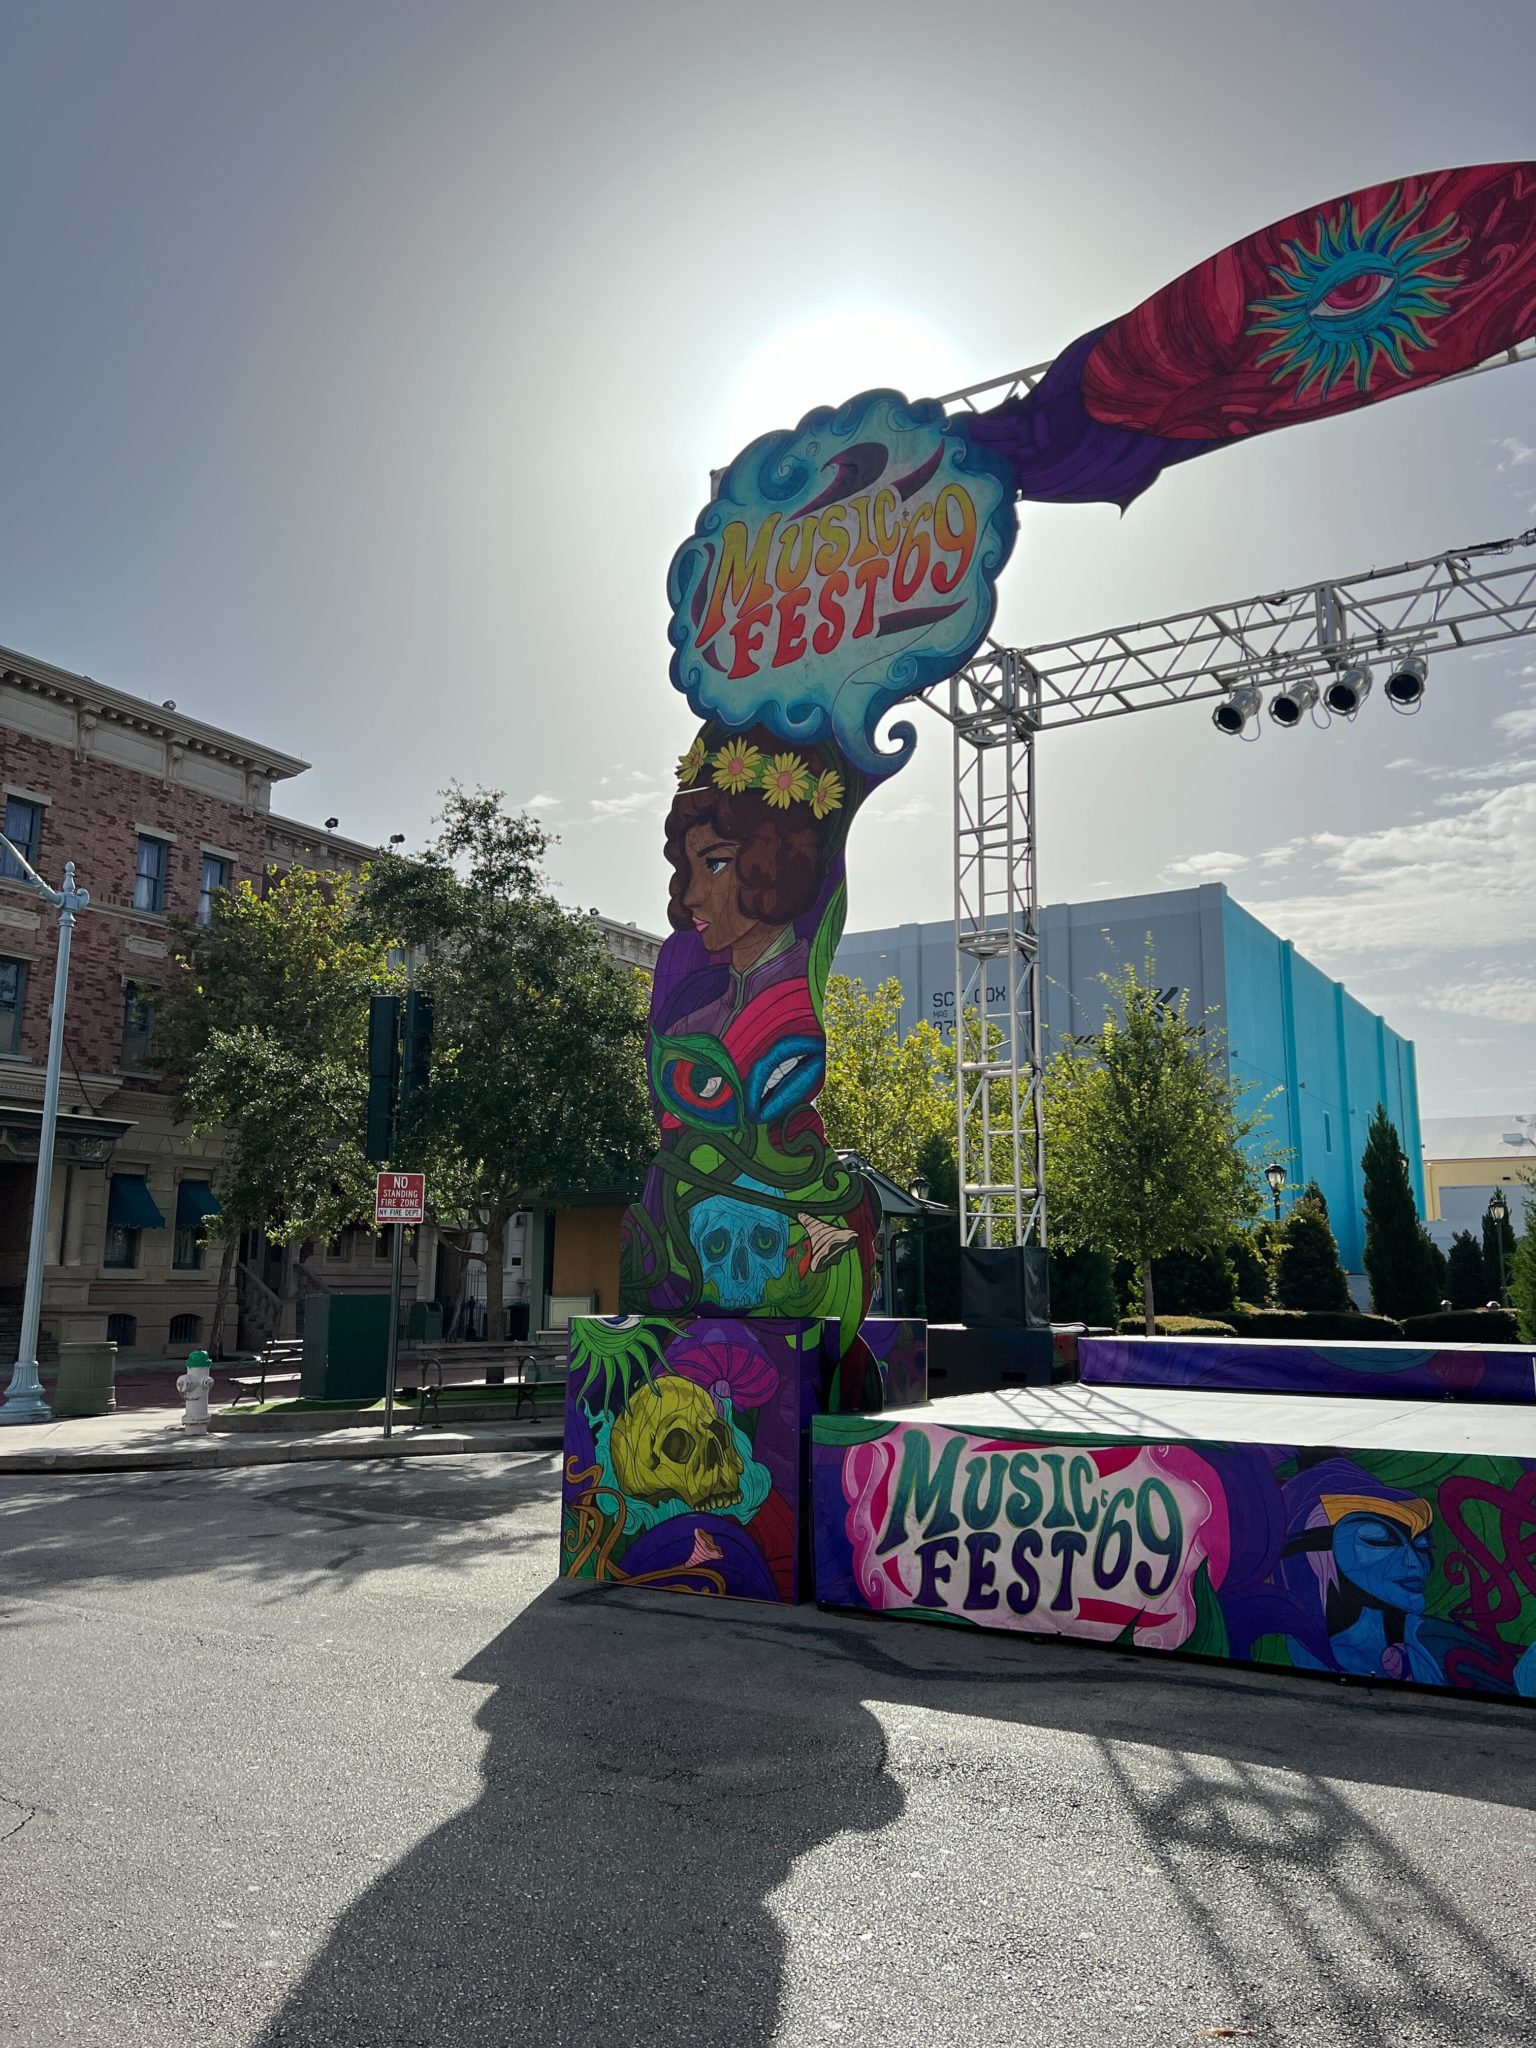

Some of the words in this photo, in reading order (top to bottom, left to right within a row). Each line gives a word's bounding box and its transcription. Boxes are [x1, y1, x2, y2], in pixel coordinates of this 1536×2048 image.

[695, 488, 903, 648] MUSIC
[726, 558, 889, 680] FEST
[380, 1198, 397, 1207] FIRE
[400, 1198, 419, 1208] ZONE
[383, 1189, 418, 1199] STANDING
[393, 1176, 409, 1189] NO
[379, 1208, 388, 1216] NY
[389, 1208, 403, 1216] FIRE
[405, 1209, 420, 1217] DEPT
[876, 1429, 1099, 1555] MUSIC
[913, 1528, 1087, 1615] FEST
